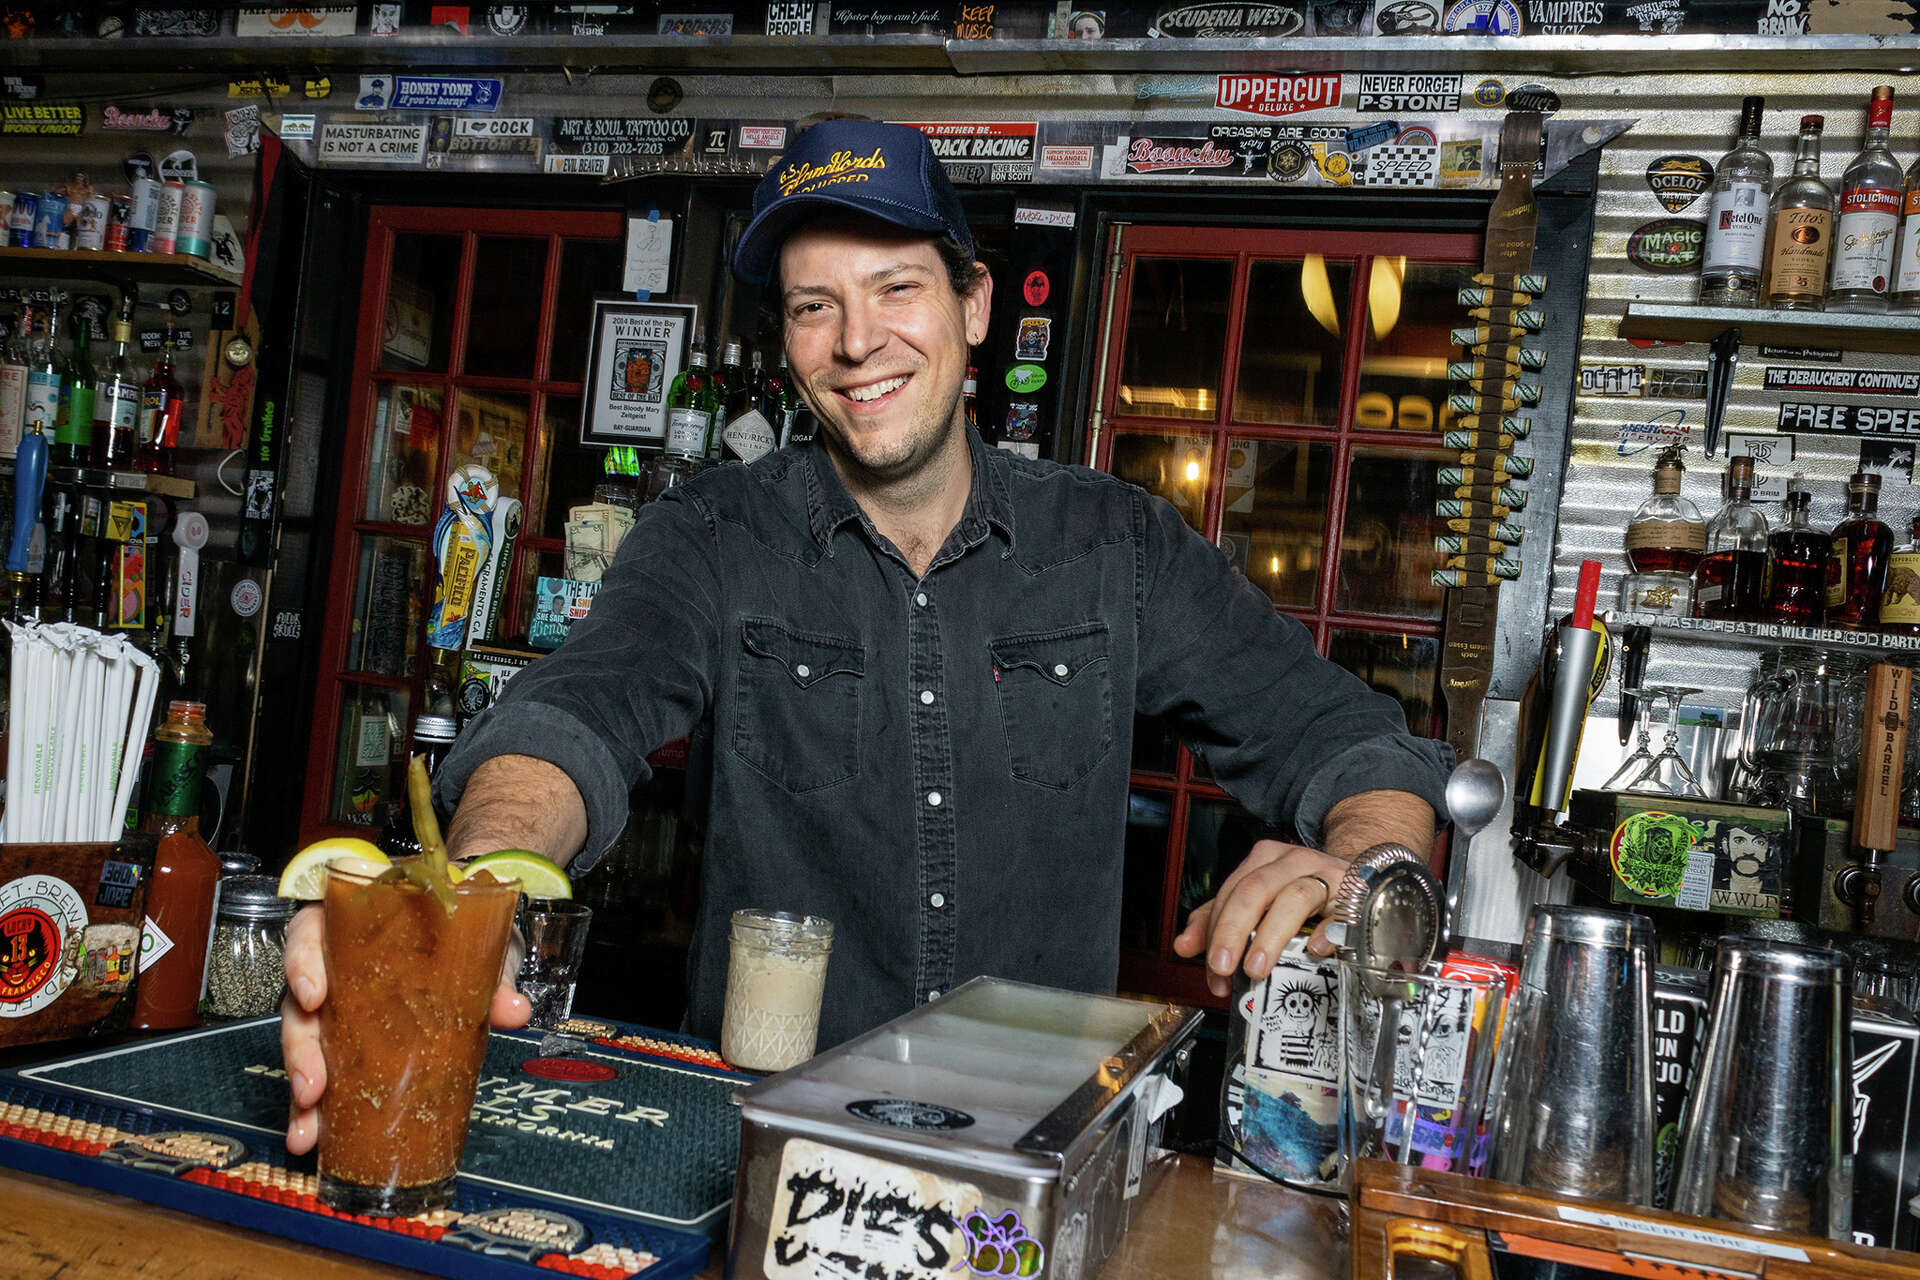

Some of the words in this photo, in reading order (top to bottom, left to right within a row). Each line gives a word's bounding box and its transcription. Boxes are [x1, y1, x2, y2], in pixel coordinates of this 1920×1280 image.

[769, 2, 813, 20] CHEAP
[961, 4, 995, 22] KEEP
[1477, 4, 1492, 12] 377
[1529, 0, 1605, 24] VAMPIRES
[834, 10, 870, 22] Hipster
[871, 11, 892, 24] boys
[1164, 10, 1240, 28] SCUDERIA
[1246, 8, 1292, 26] WEST
[768, 20, 812, 35] PEOPLE
[956, 24, 995, 40] MUSIC
[400, 81, 440, 95] HONKY
[441, 83, 473, 97] TONK
[1219, 76, 1338, 107] UPPERCUT
[1363, 76, 1406, 93] NEVER
[1408, 77, 1458, 93] FORGET
[1258, 102, 1294, 113] DELUXE
[1358, 95, 1459, 111] P-STONE
[4, 106, 33, 119] LIVE
[33, 106, 82, 119] BETTER
[325, 127, 420, 140] MASTURBATING
[490, 121, 530, 134] COCK
[560, 119, 583, 135] ART
[594, 120, 623, 136] SOUL
[625, 120, 669, 137] TATTOO
[671, 120, 690, 137] CO.
[937, 126, 976, 135] RATHER
[1211, 127, 1272, 137] ORGASMS
[1277, 127, 1303, 138] ARE
[1309, 127, 1347, 139] GOOD
[323, 141, 334, 152] IS
[338, 142, 364, 153] NOT
[367, 142, 377, 152] A
[380, 142, 419, 153] CRIME
[582, 142, 609, 155] (310)
[611, 142, 664, 155] 202-7203
[929, 139, 970, 157] RACK
[971, 139, 1031, 157] RACING
[992, 164, 1011, 172] NEVER
[1012, 164, 1033, 172] FORGET
[1372, 160, 1432, 172] SPEED
[1007, 172, 1033, 181] SCOTT
[1651, 175, 1706, 192] OCELOT
[1789, 211, 1825, 225] Tito's
[1645, 229, 1703, 252] MAGIC
[1650, 249, 1697, 264] HAT
[1780, 246, 1825, 258] Handmade
[629, 318, 643, 326] Best
[615, 325, 671, 338] WINNER
[1767, 369, 1787, 384] THE
[1788, 370, 1857, 387] DEBAUCHERY
[1858, 373, 1920, 390] CONTINUES
[1780, 403, 1849, 430] FREE
[1855, 407, 1920, 434] SPEE
[500, 542, 512, 569] KING
[494, 569, 506, 599] CONG
[565, 581, 583, 597] THE
[180, 570, 193, 619] CIDER
[485, 600, 500, 641] BREWIN
[1782, 627, 1808, 640] WILL
[1812, 629, 1842, 642] HELP
[1882, 635, 1920, 650] PARTY
[1886, 667, 1904, 712] WILD
[1878, 732, 1896, 797] BARREL
[35, 880, 83, 924] BREW
[10, 933, 28, 963] 13
[1, 960, 52, 997] FRANCISCO
[1656, 1008, 1686, 1034] LD
[1618, 1220, 1686, 1238] INSERT
[1692, 1233, 1748, 1248] HERE
